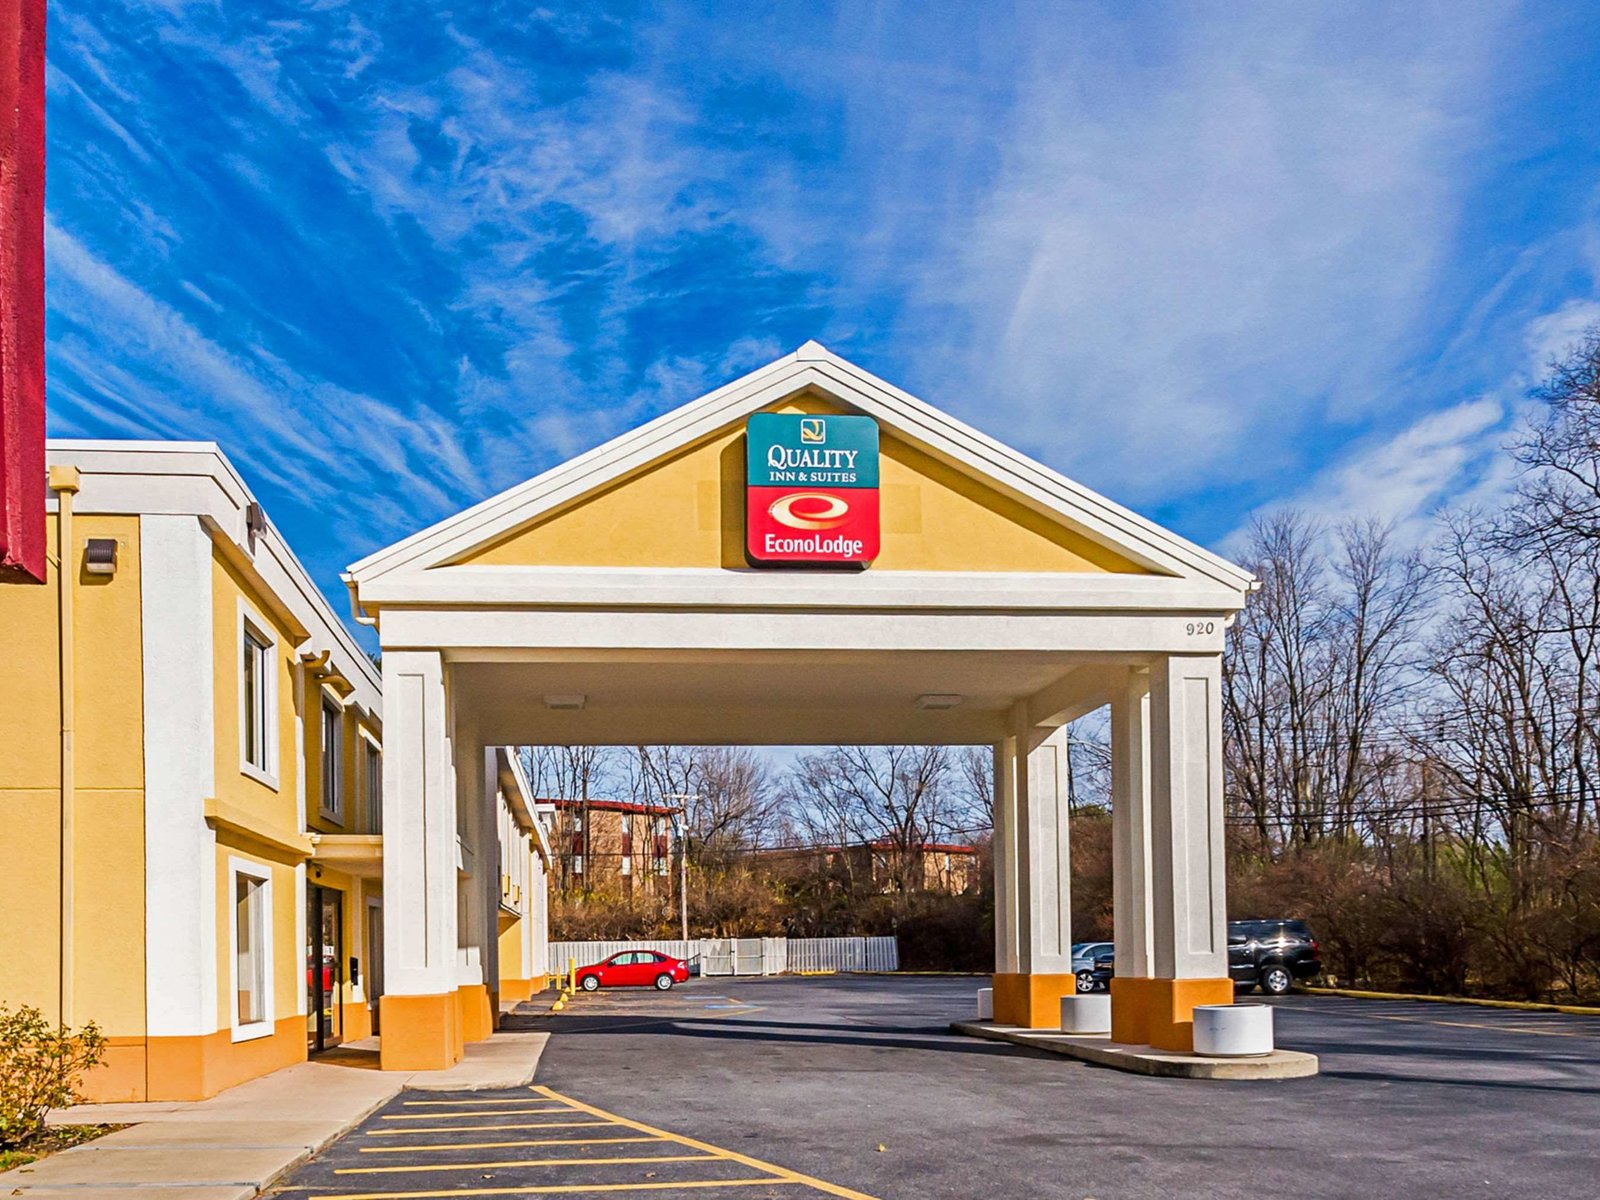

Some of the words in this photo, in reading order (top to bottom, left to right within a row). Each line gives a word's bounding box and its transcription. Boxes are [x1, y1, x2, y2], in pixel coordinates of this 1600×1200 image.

[767, 444, 858, 470] QUALITY
[769, 471, 796, 482] INN
[798, 472, 808, 482] &
[811, 472, 857, 483] SUITES
[765, 533, 863, 558] EconoLodge
[1186, 621, 1214, 636] 920
